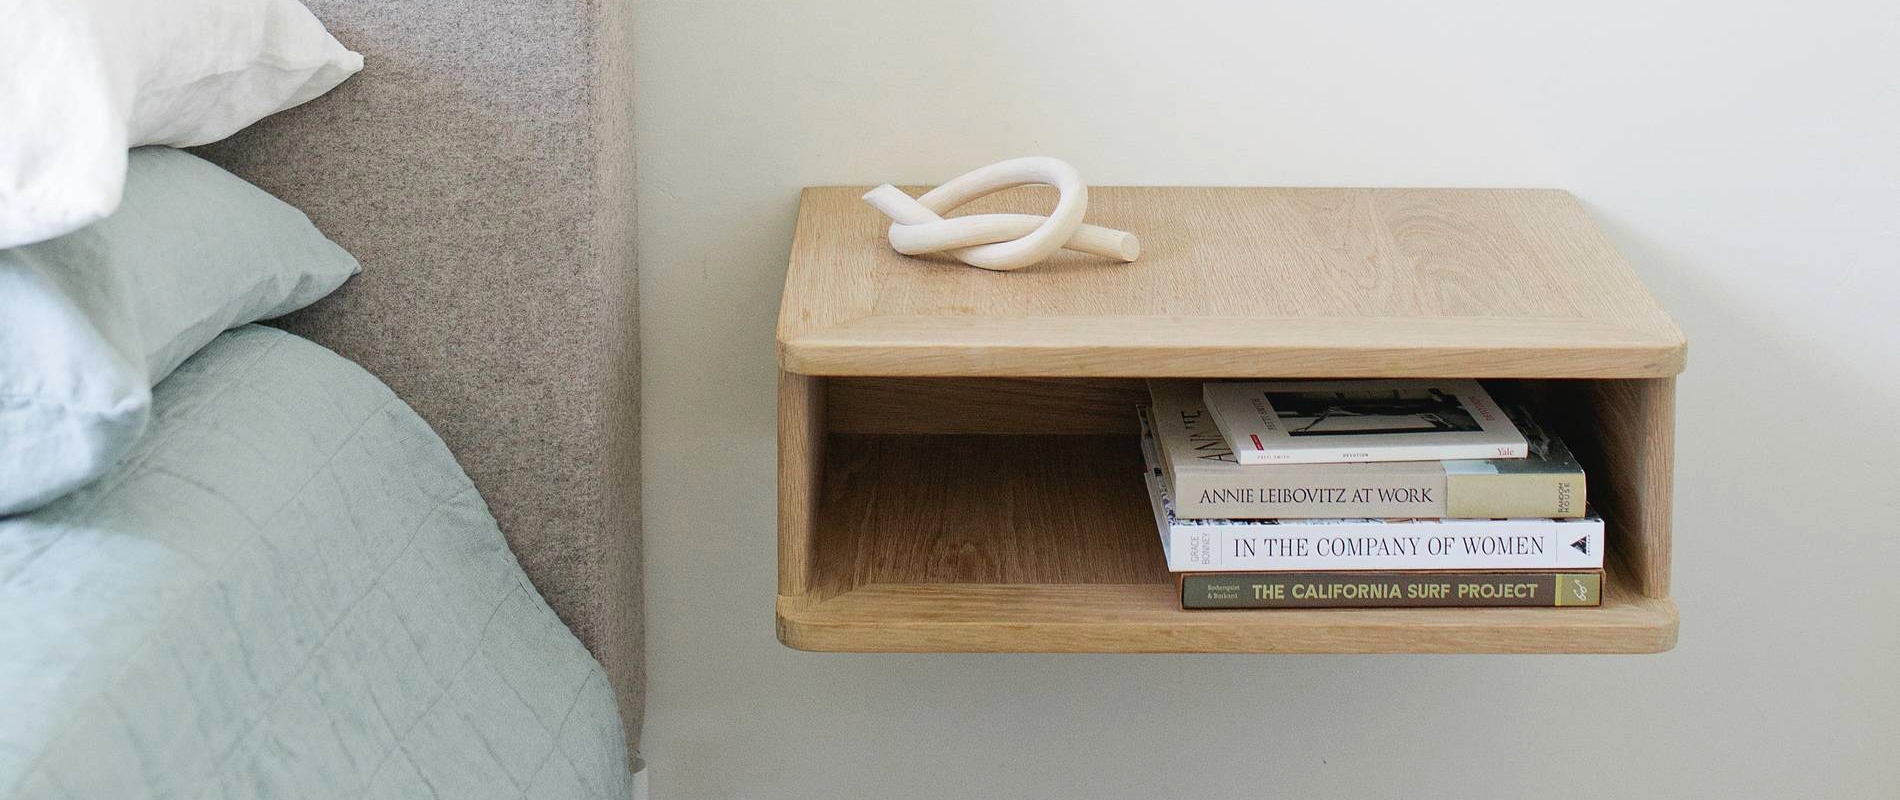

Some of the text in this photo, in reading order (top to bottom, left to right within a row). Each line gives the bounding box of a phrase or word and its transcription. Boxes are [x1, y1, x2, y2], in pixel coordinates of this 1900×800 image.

[1497, 447, 1515, 457] Yale
[1199, 487, 1434, 504] ANNIE LEIBOVITZ AT WORK
[1190, 535, 1200, 563] GRACE
[1202, 533, 1211, 565] BONNEY
[1233, 535, 1545, 558] IN THE COMPANY OF WOMEN
[1252, 583, 1539, 600] THE CALIFORNIA SURF PROJECT
